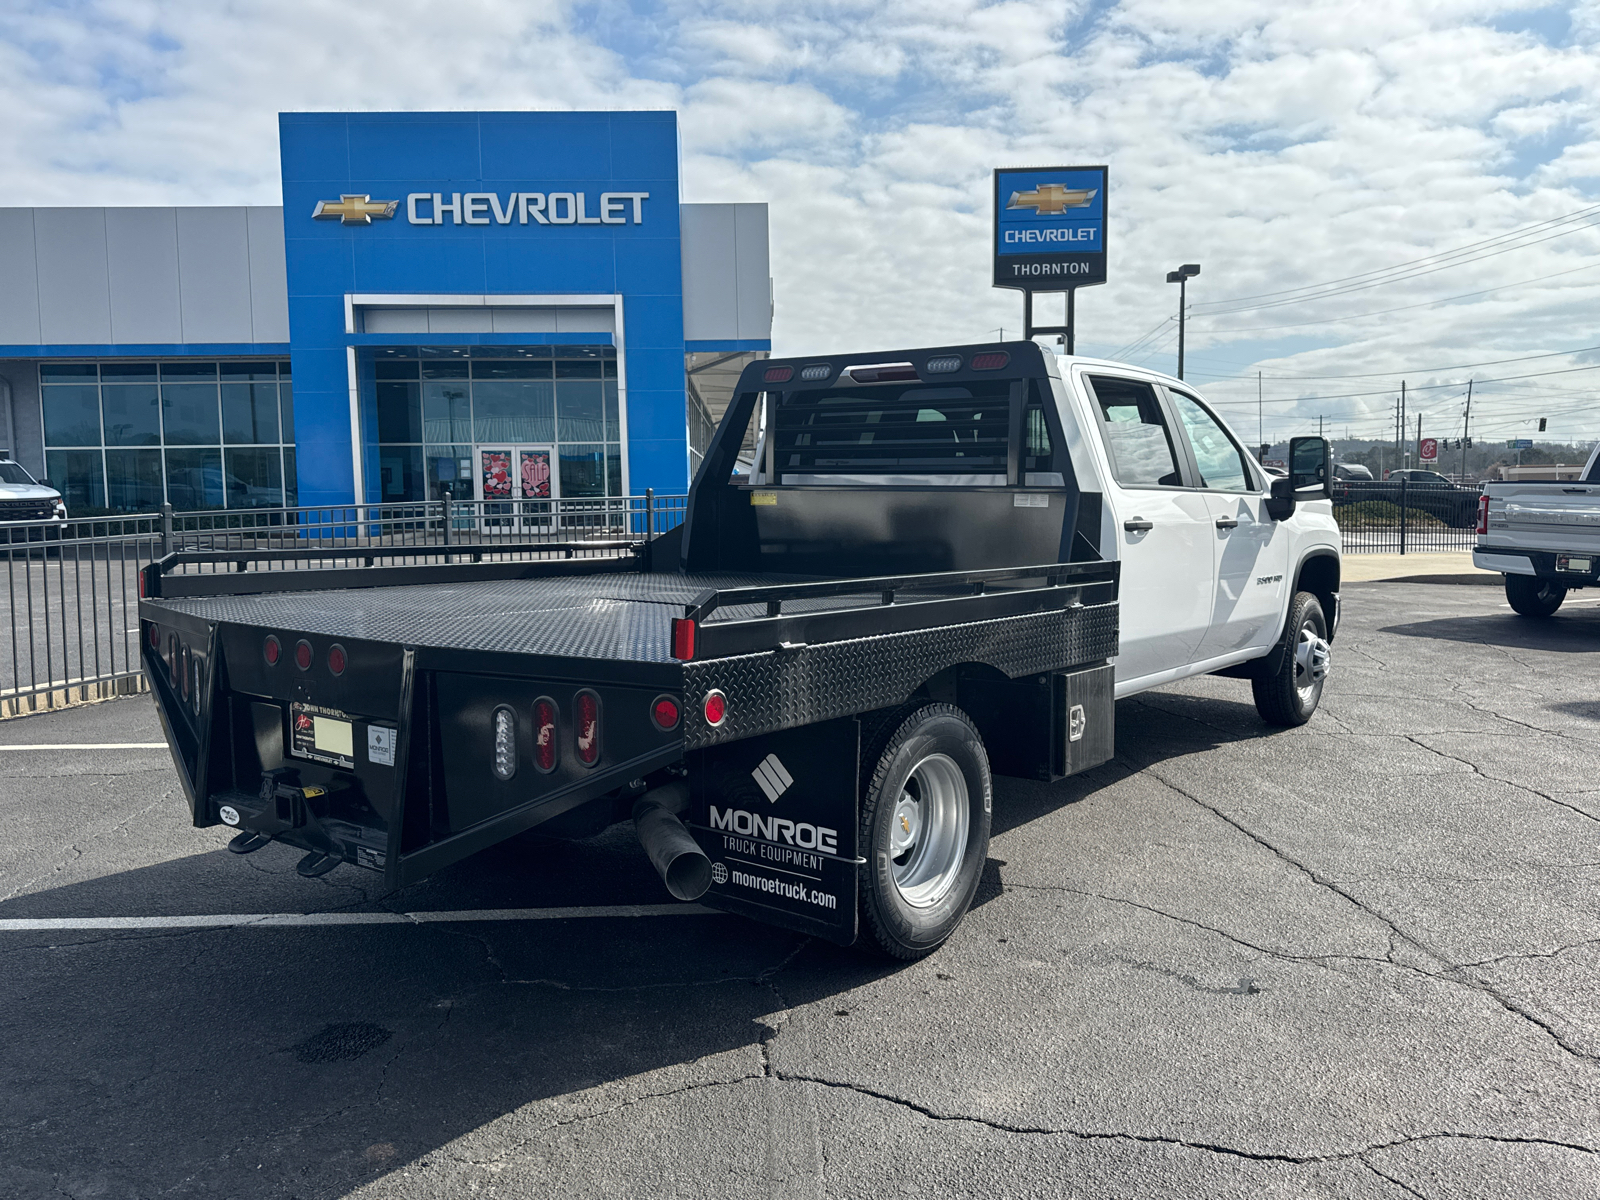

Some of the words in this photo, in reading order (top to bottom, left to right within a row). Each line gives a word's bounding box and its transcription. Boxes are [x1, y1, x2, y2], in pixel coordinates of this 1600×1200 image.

[407, 192, 650, 225] CHEVROLET
[1004, 228, 1097, 243] CHEVROLET
[1012, 262, 1090, 276] THORNTON
[524, 463, 547, 482] SALE
[302, 702, 319, 713] JOHN
[709, 805, 838, 855] MONROE
[723, 835, 757, 856] TRUCK
[760, 844, 825, 871] EQUIPMENT
[732, 869, 837, 910] monroetruck.com
